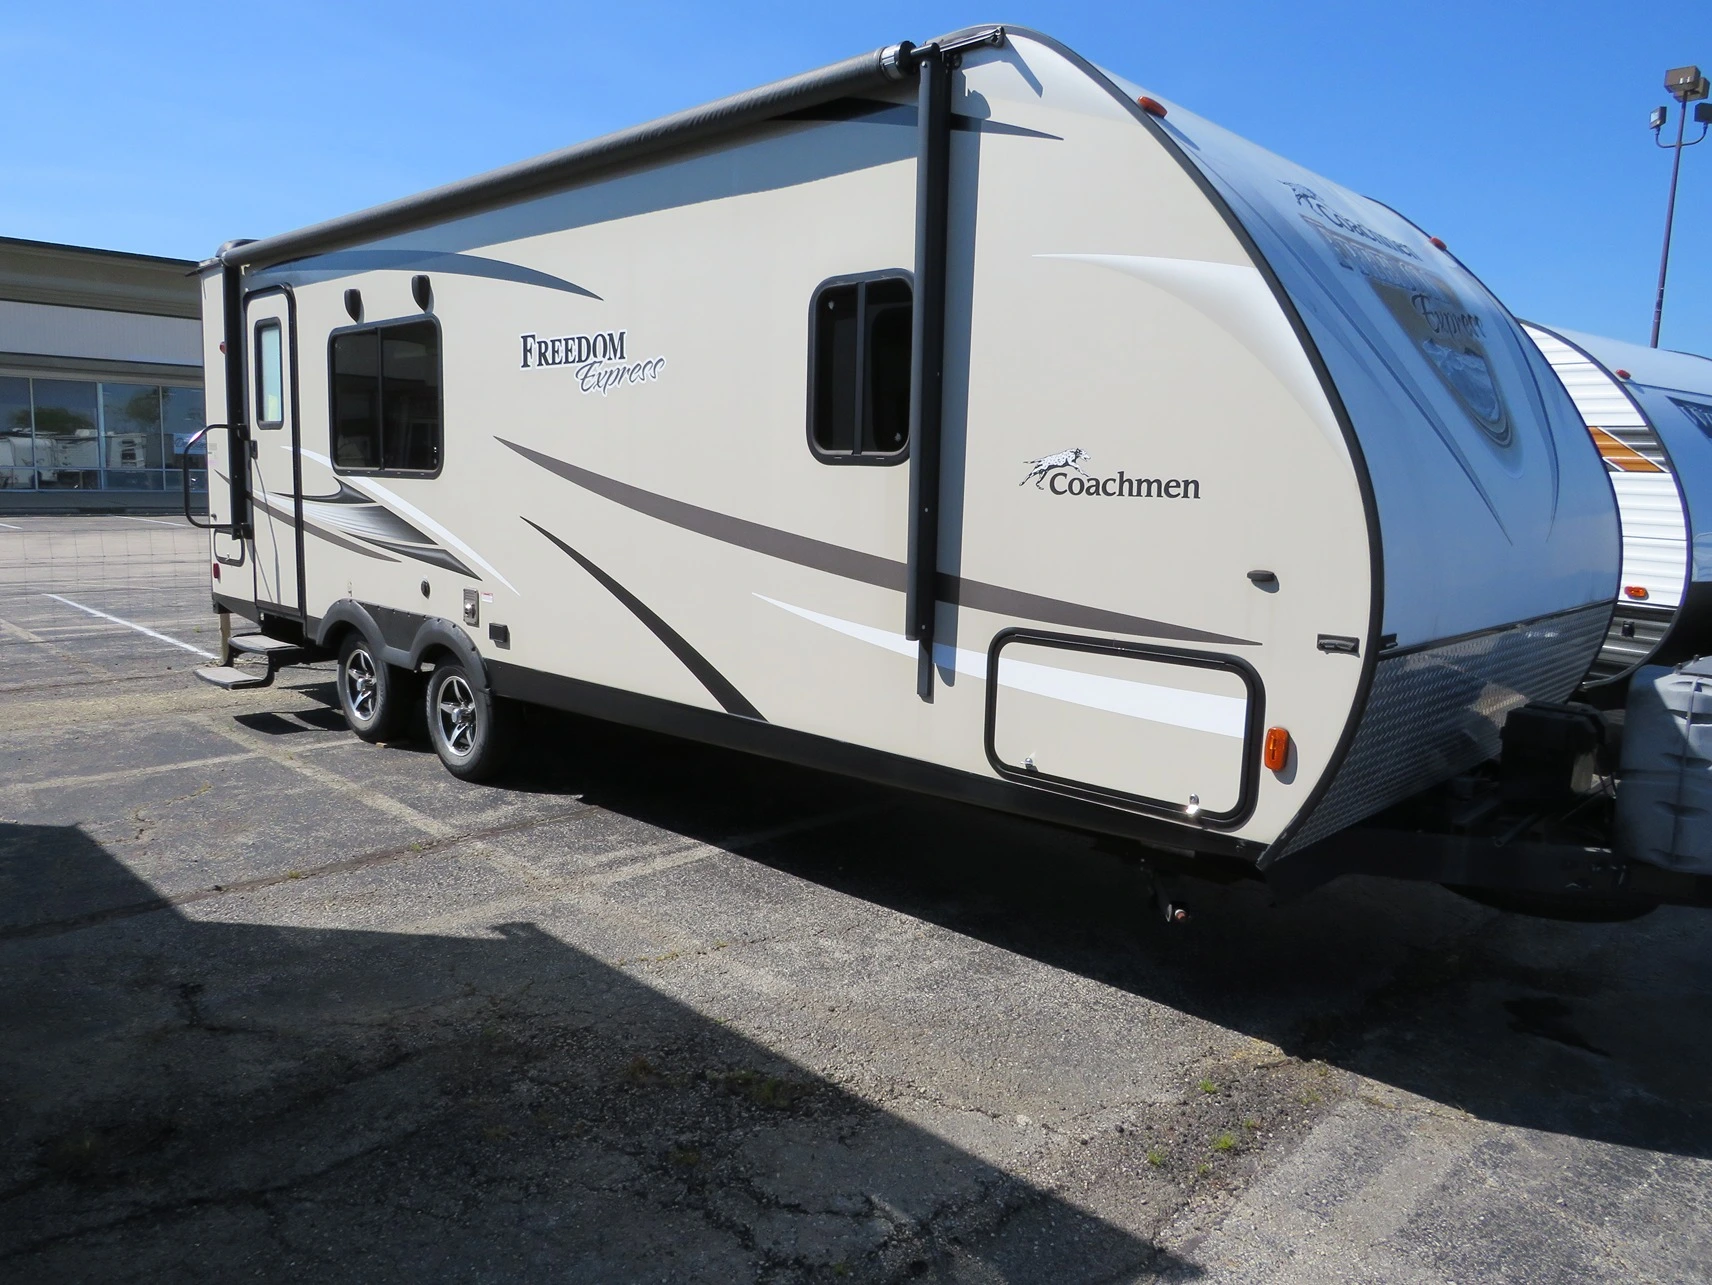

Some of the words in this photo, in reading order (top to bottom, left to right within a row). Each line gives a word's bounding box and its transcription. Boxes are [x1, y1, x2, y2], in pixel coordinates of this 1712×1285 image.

[521, 331, 626, 368] FREEDOM
[575, 358, 665, 395] Express
[1049, 471, 1200, 499] Coachmen
